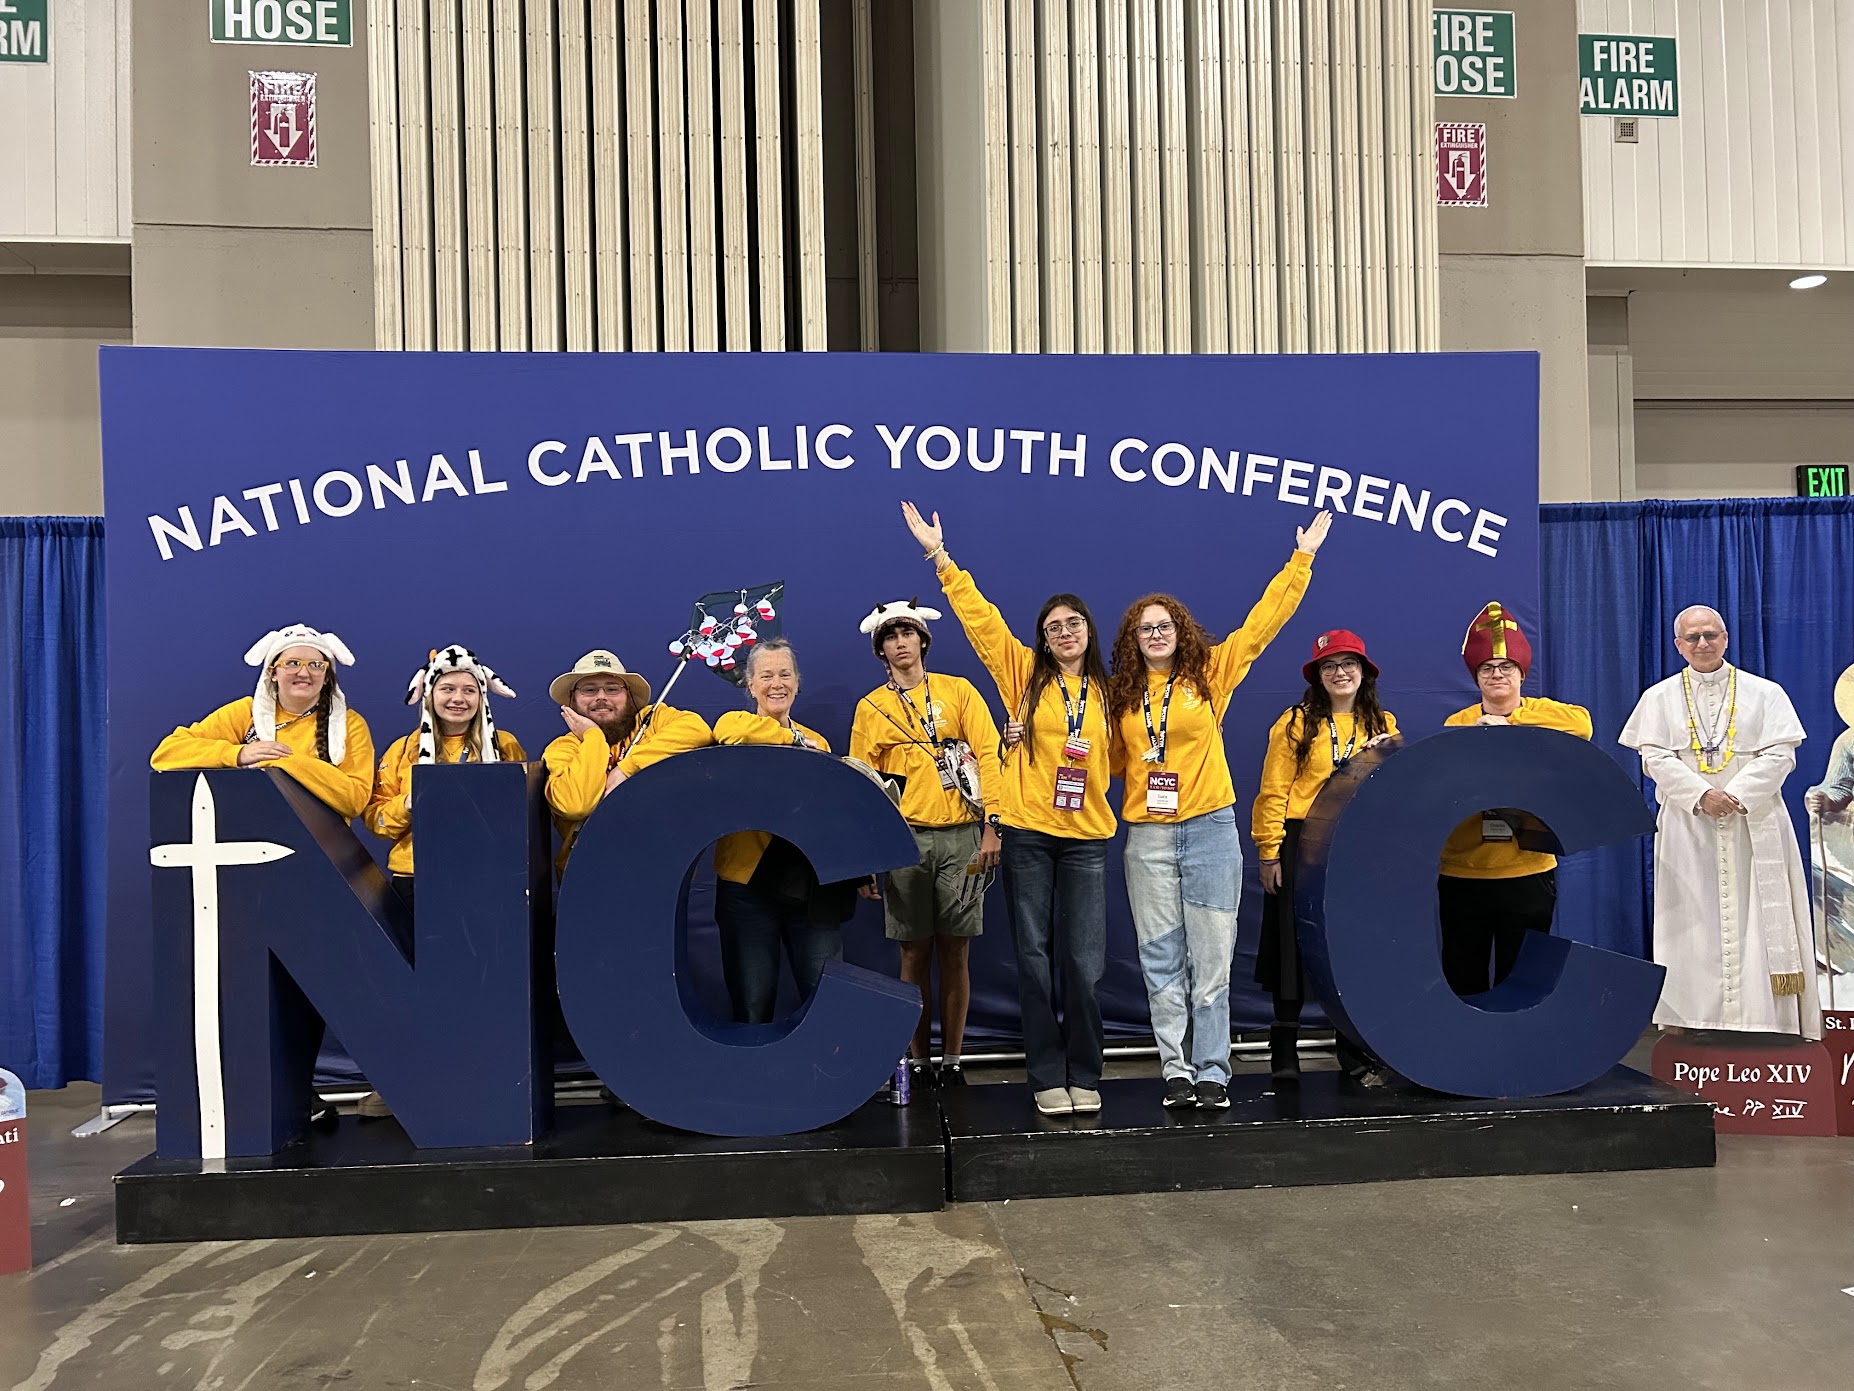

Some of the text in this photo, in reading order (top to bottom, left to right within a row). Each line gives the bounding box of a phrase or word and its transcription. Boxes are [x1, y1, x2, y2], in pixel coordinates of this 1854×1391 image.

[224, 0, 339, 41] HOSE
[1593, 40, 1655, 73] FIRE
[1580, 77, 1674, 111] ALARM
[1443, 129, 1475, 143] FIRE
[147, 424, 1508, 561] NATIONAL CATHOLIC YOUTH CONFERENCE
[1807, 467, 1845, 497] EXIT
[1149, 776, 1176, 787] NCYC
[1825, 1016, 1847, 1030] St.
[1674, 1062, 1812, 1090] Pope Leo XIV
